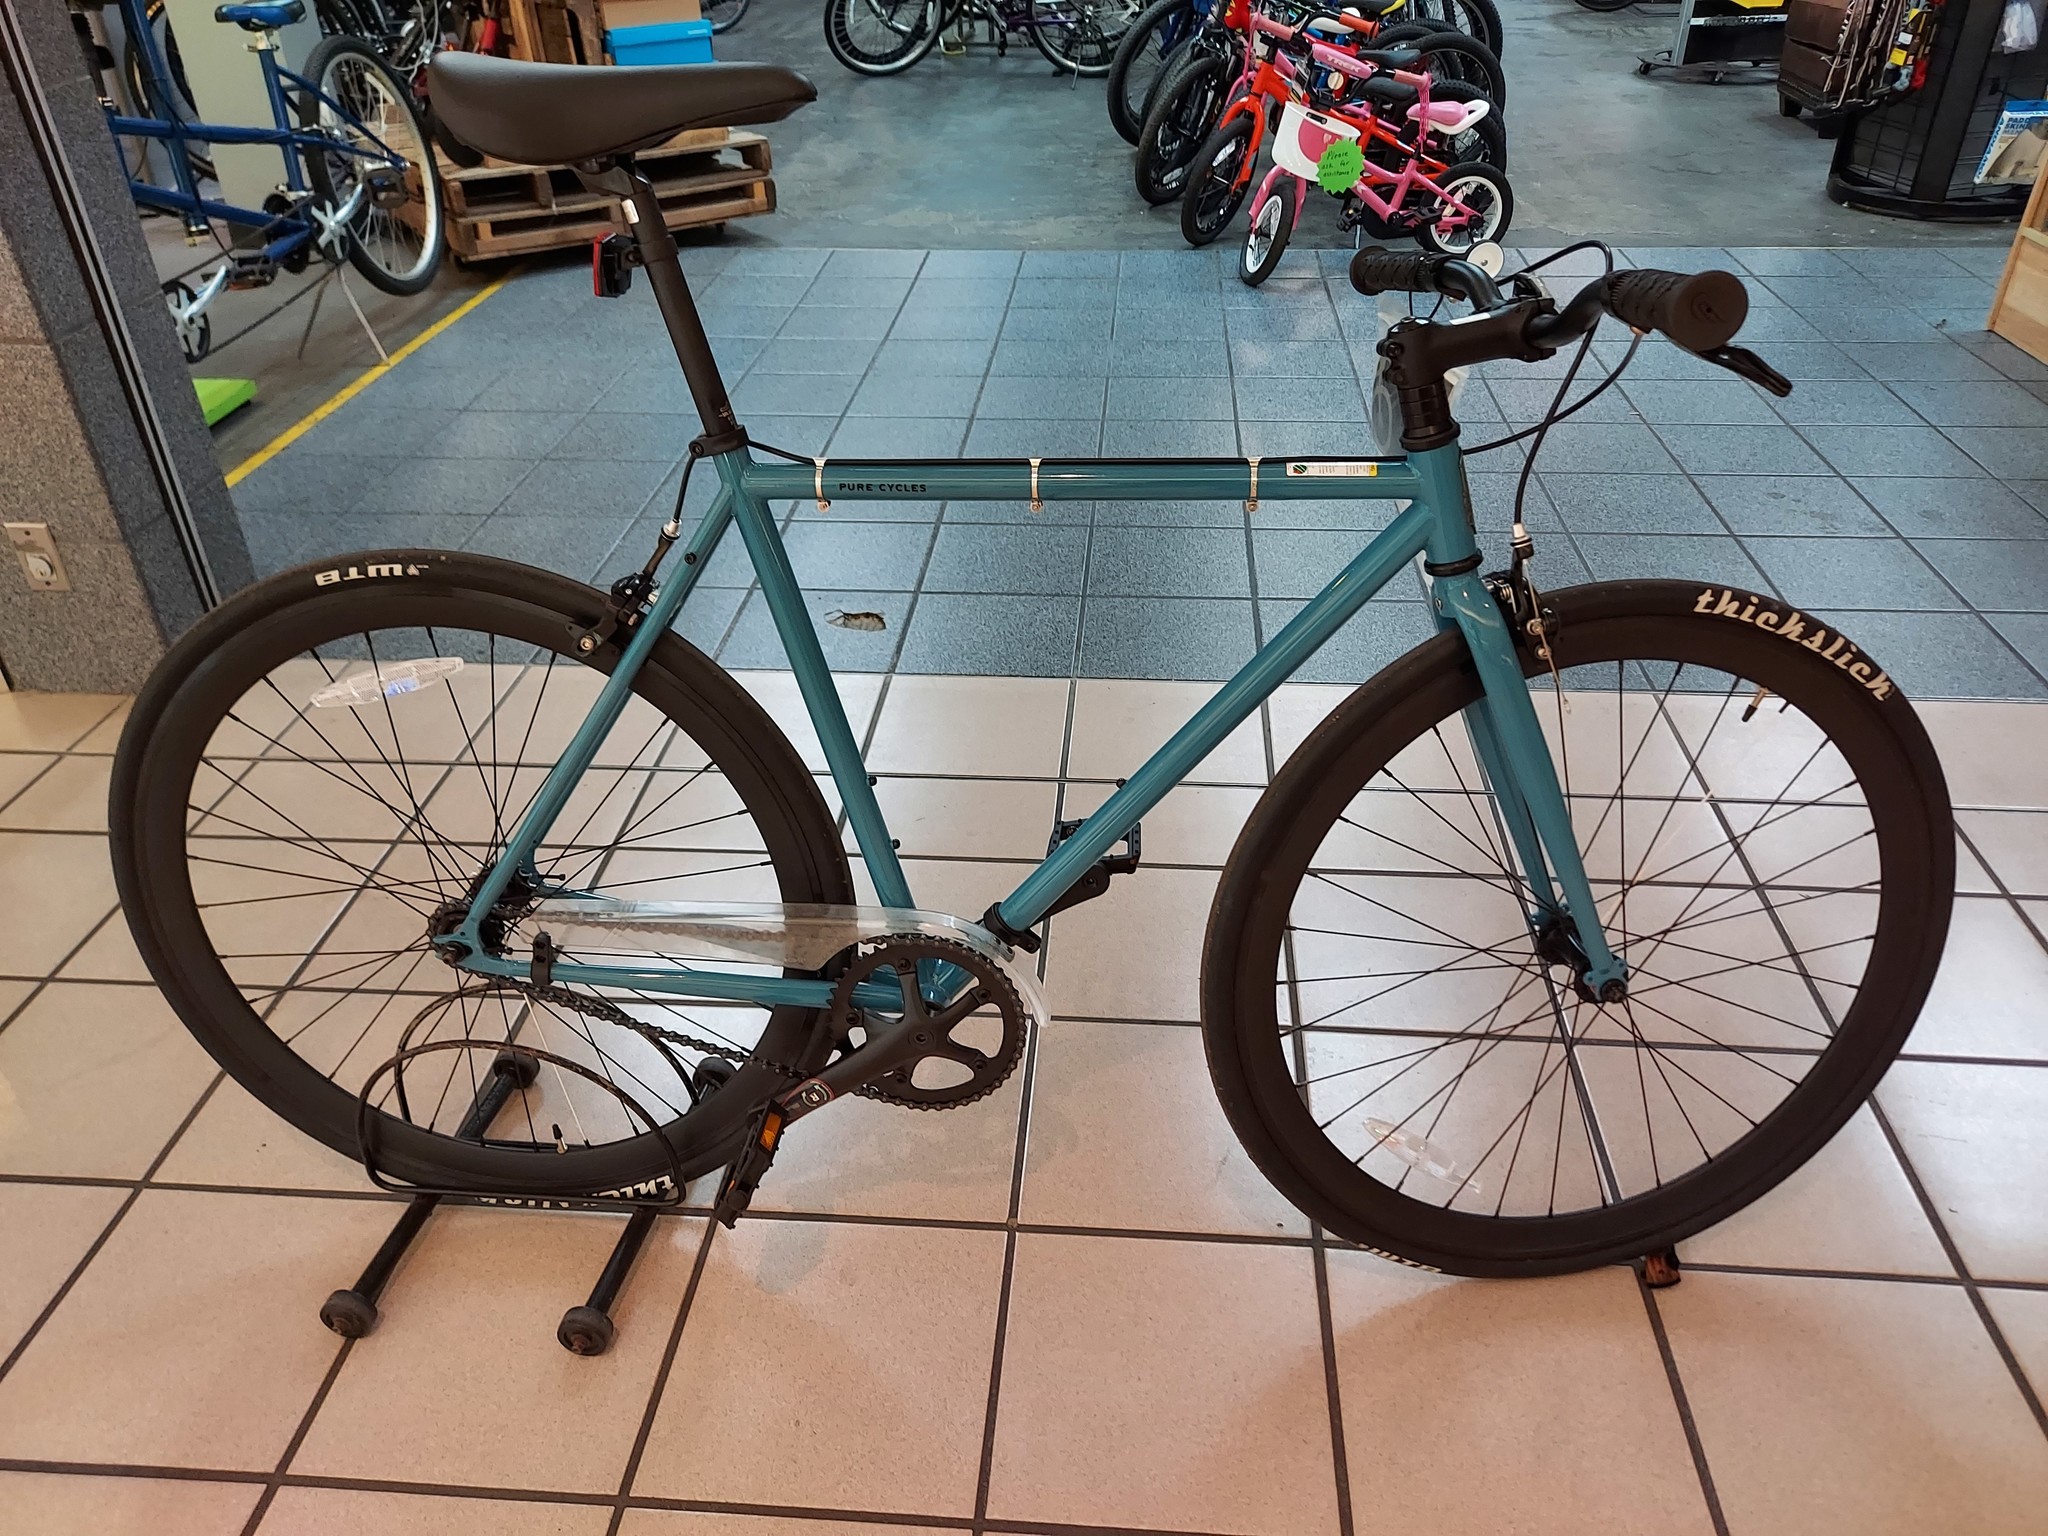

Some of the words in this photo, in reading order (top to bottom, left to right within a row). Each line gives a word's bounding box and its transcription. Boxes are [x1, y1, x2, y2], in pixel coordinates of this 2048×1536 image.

[1326, 54, 1360, 73] TREK
[1327, 151, 1348, 160] Please
[839, 483, 873, 491] PURE
[879, 483, 927, 492] CYCLES
[315, 563, 403, 586] WTB
[1693, 588, 1894, 702] thickslick
